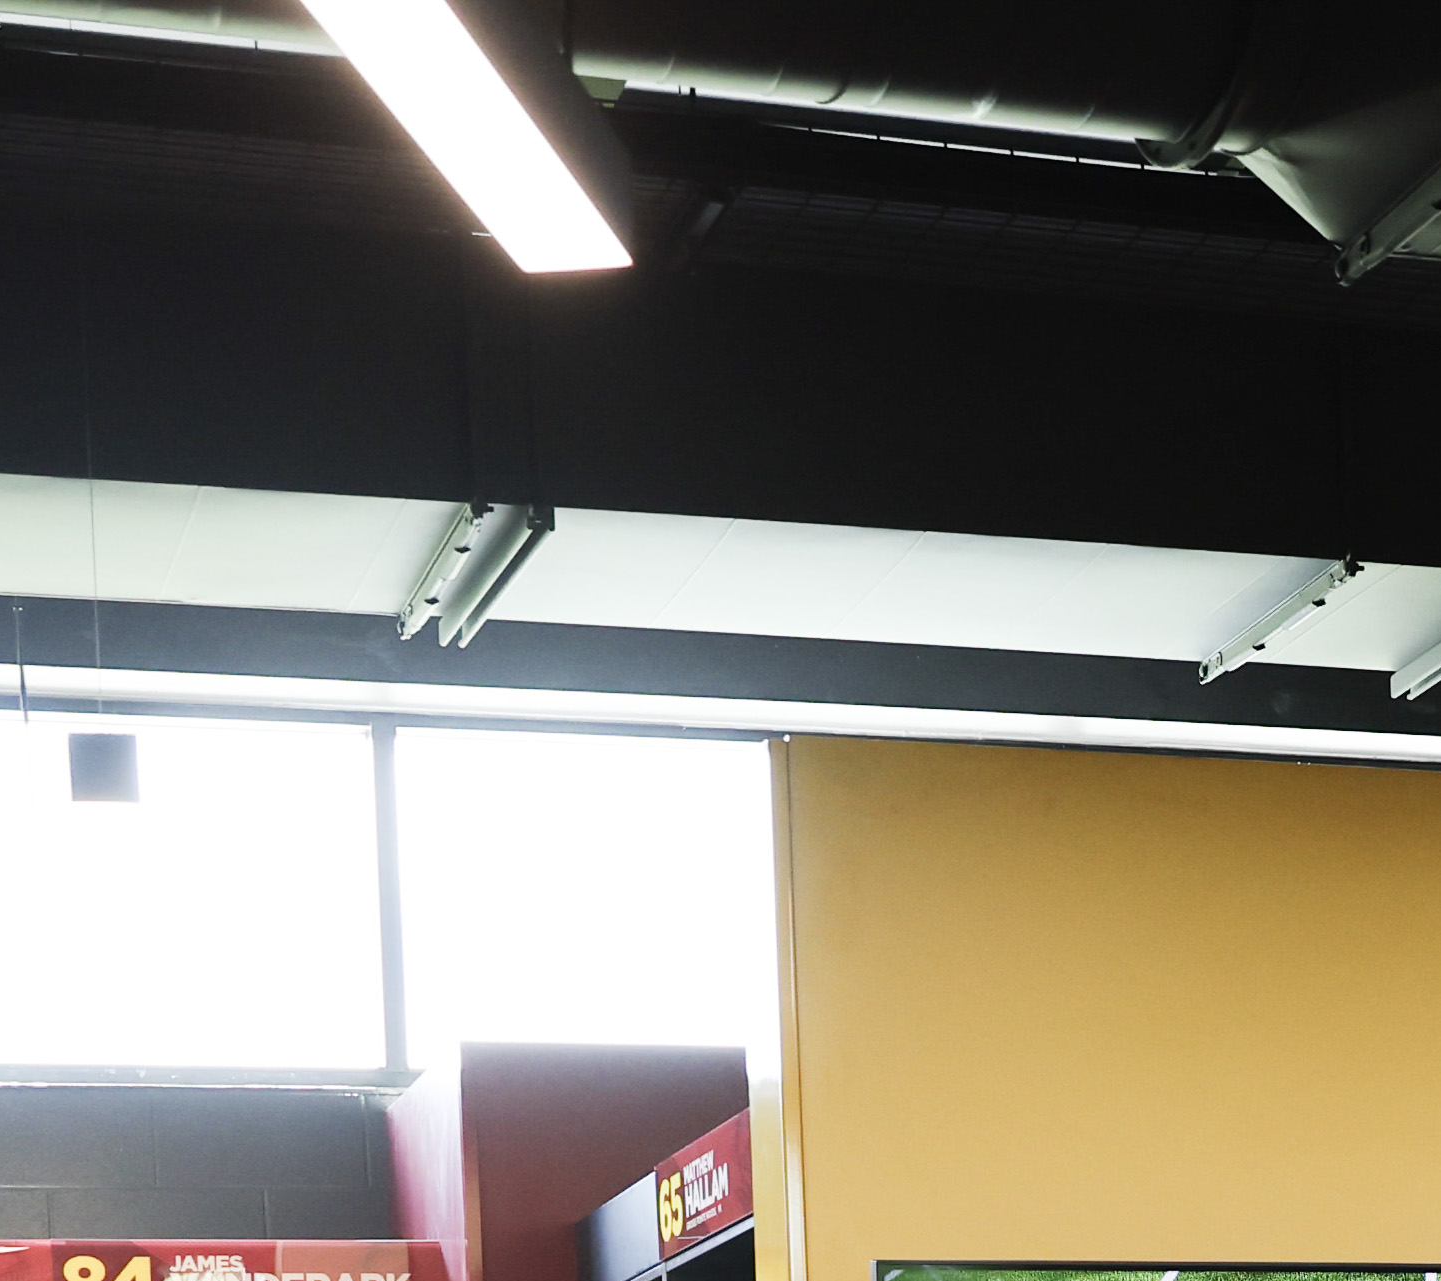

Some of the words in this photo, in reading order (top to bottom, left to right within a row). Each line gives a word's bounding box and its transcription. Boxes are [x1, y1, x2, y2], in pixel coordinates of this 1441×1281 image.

[659, 1171, 684, 1242] 65
[684, 1162, 728, 1218] HALLAM
[169, 1255, 244, 1271] JAMES
